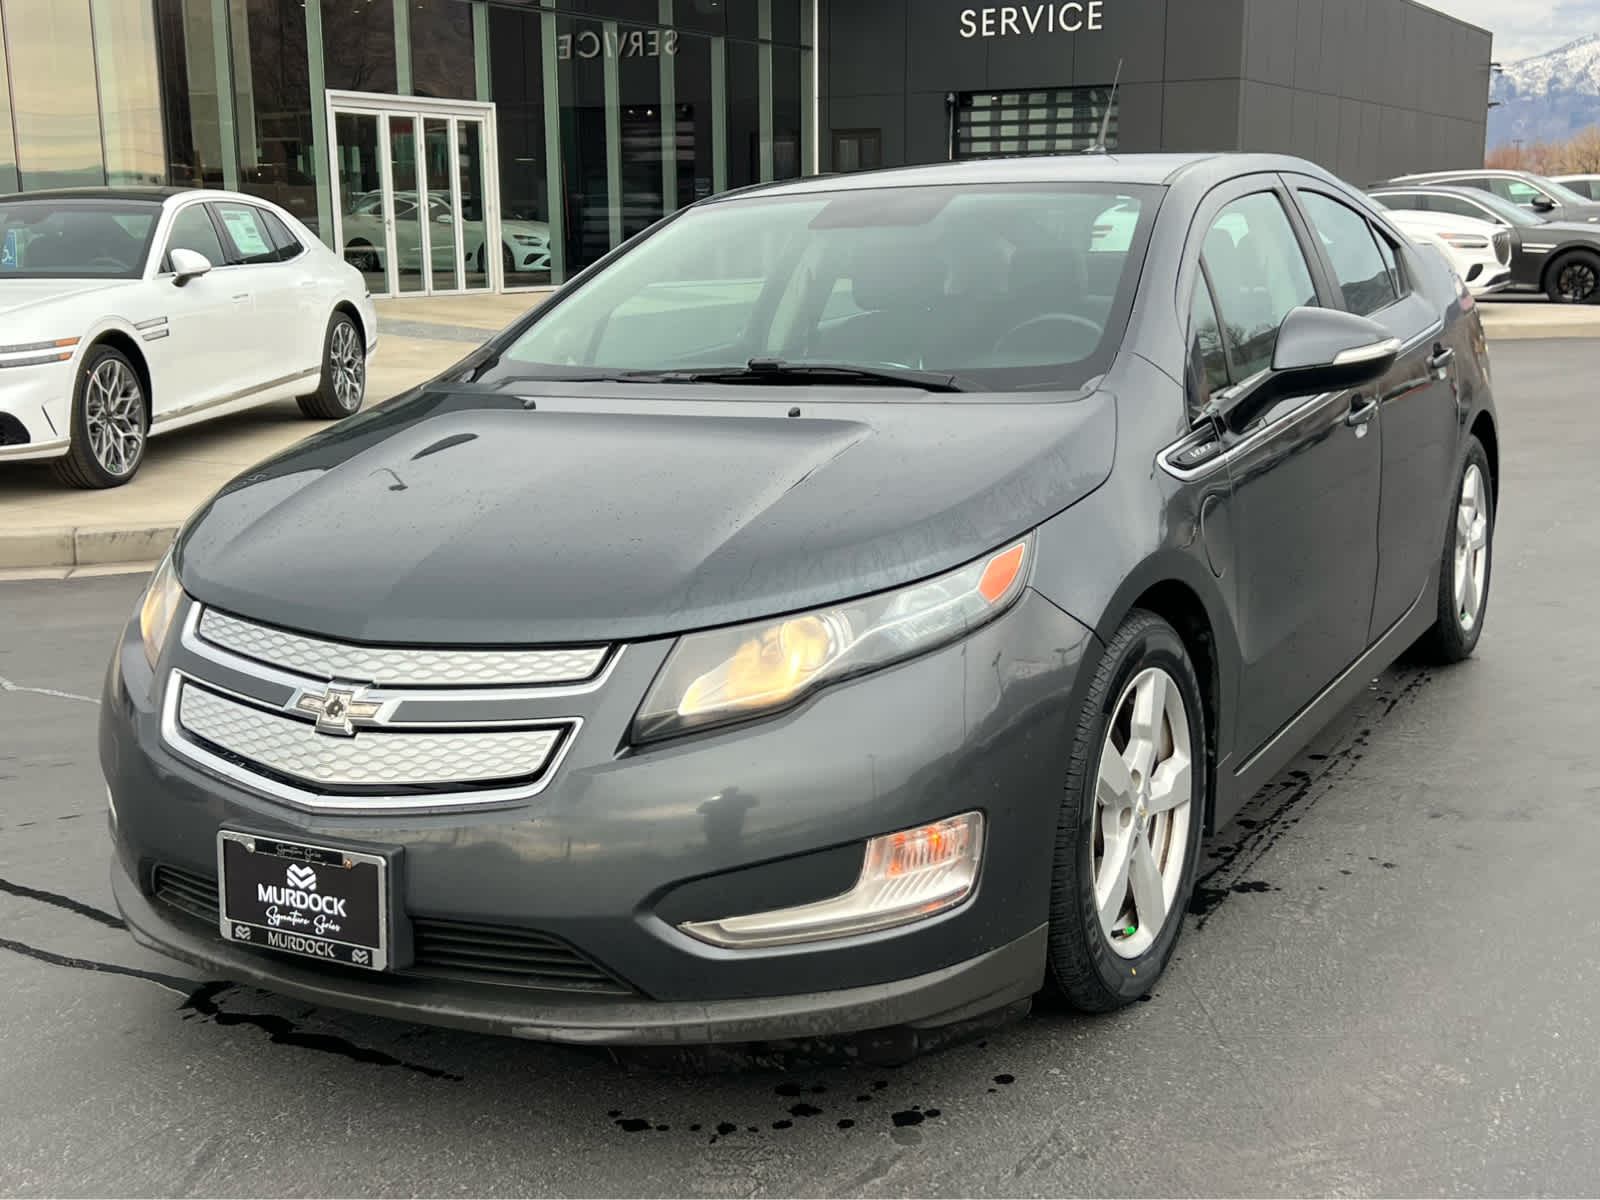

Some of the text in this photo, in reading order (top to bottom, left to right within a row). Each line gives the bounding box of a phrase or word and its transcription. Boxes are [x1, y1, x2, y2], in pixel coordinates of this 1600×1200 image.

[959, 1, 1103, 38] SERVICE
[257, 883, 347, 917] MURDOCK
[267, 931, 335, 958] MURDOCK
